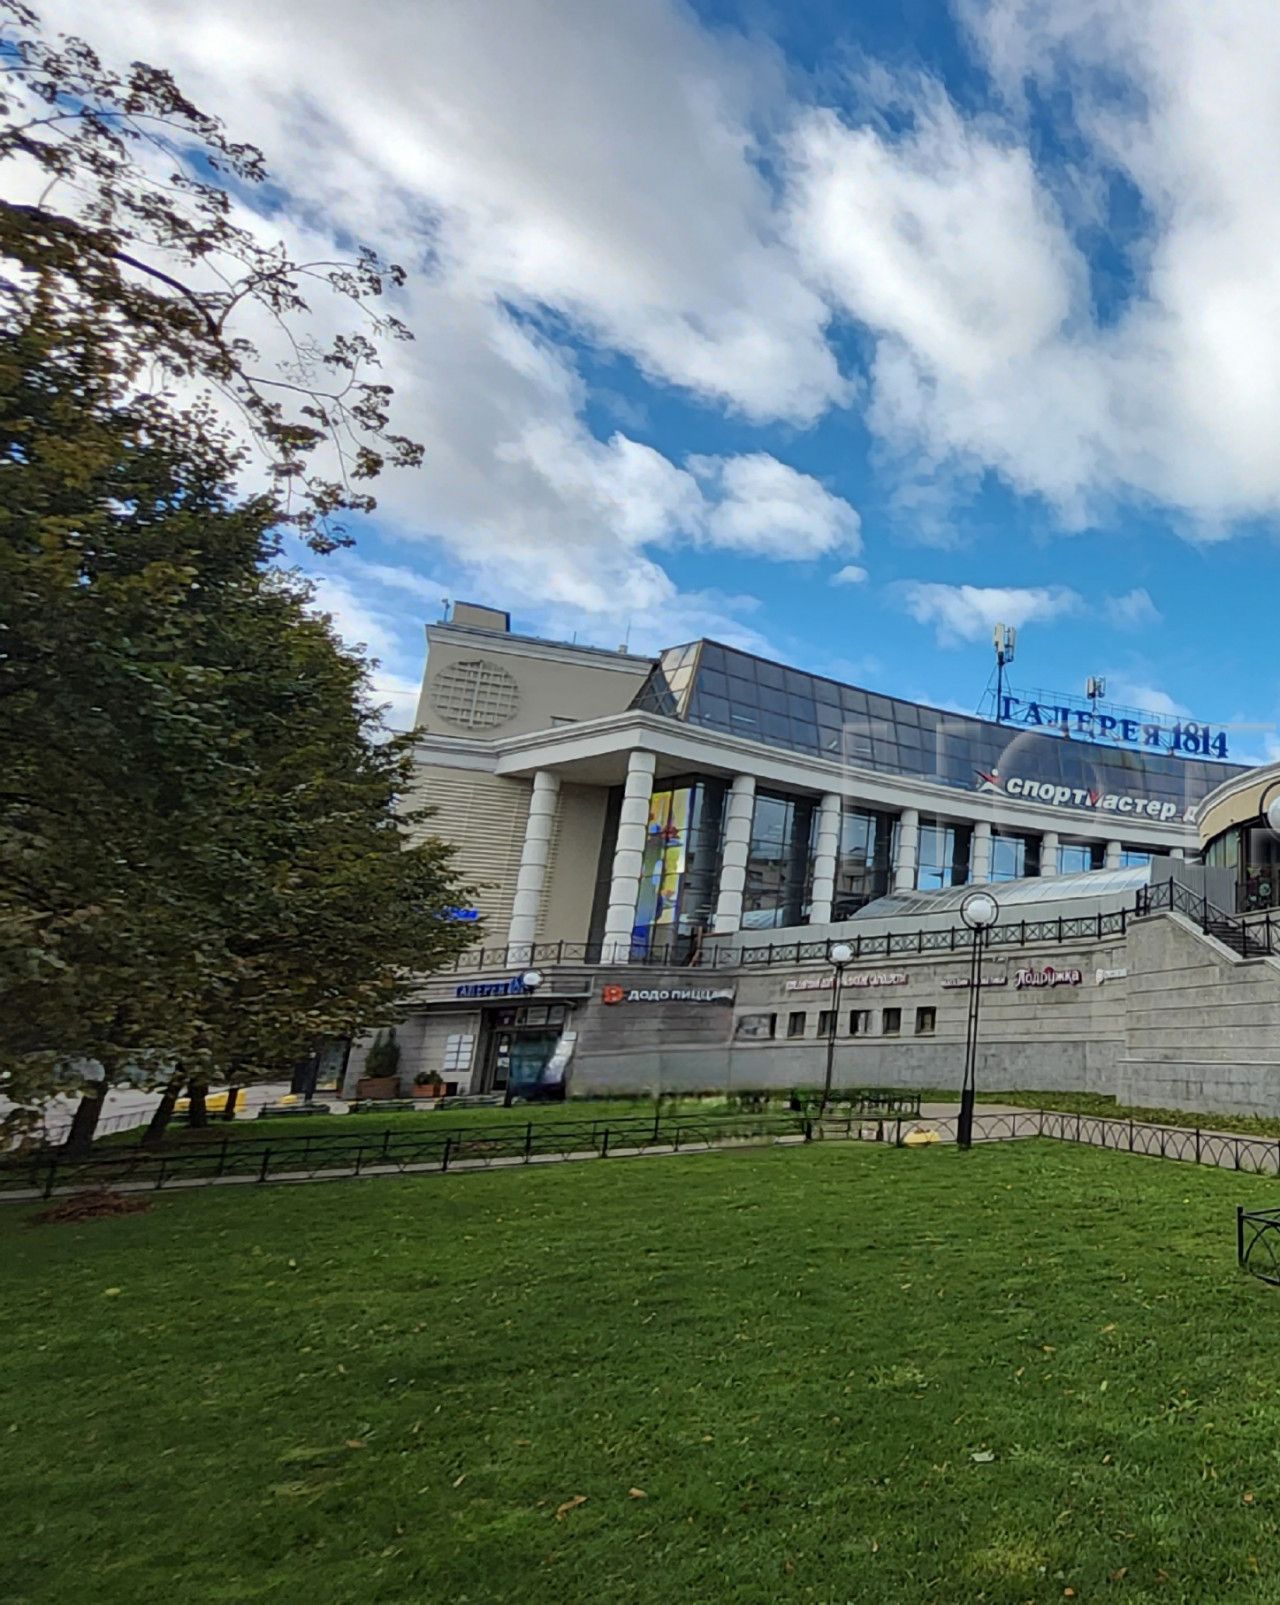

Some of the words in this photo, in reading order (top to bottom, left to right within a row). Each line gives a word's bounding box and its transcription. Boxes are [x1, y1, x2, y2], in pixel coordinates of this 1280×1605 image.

[1000, 695, 1160, 746] ГАЛЕРЕЯ
[1172, 721, 1229, 758] 1814
[1007, 777, 1175, 821] спортмастер
